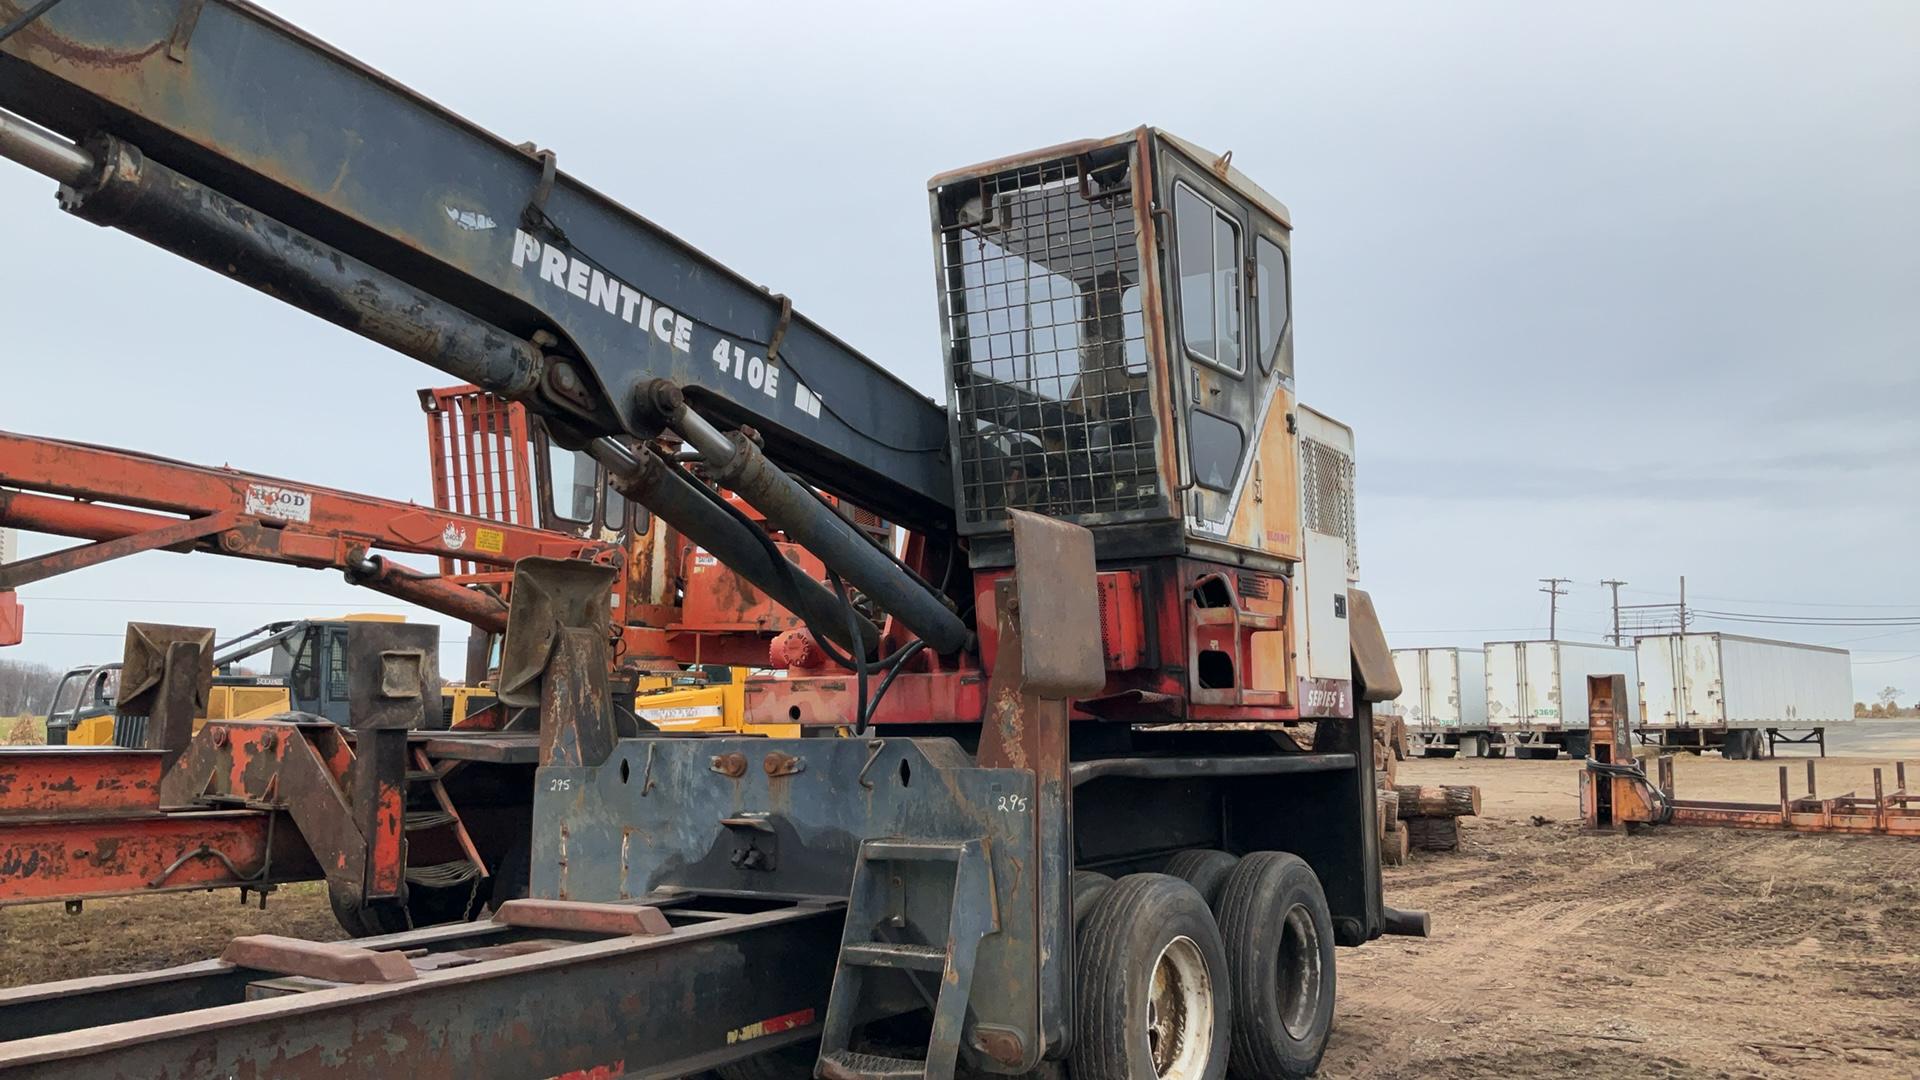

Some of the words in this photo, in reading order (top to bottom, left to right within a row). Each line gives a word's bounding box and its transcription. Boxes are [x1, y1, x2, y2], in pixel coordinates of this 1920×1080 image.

[512, 228, 693, 353] PRENTICE
[712, 338, 780, 399] 410E
[1307, 690, 1337, 707] SERIES
[550, 778, 571, 792] 295
[997, 794, 1028, 813] 295
